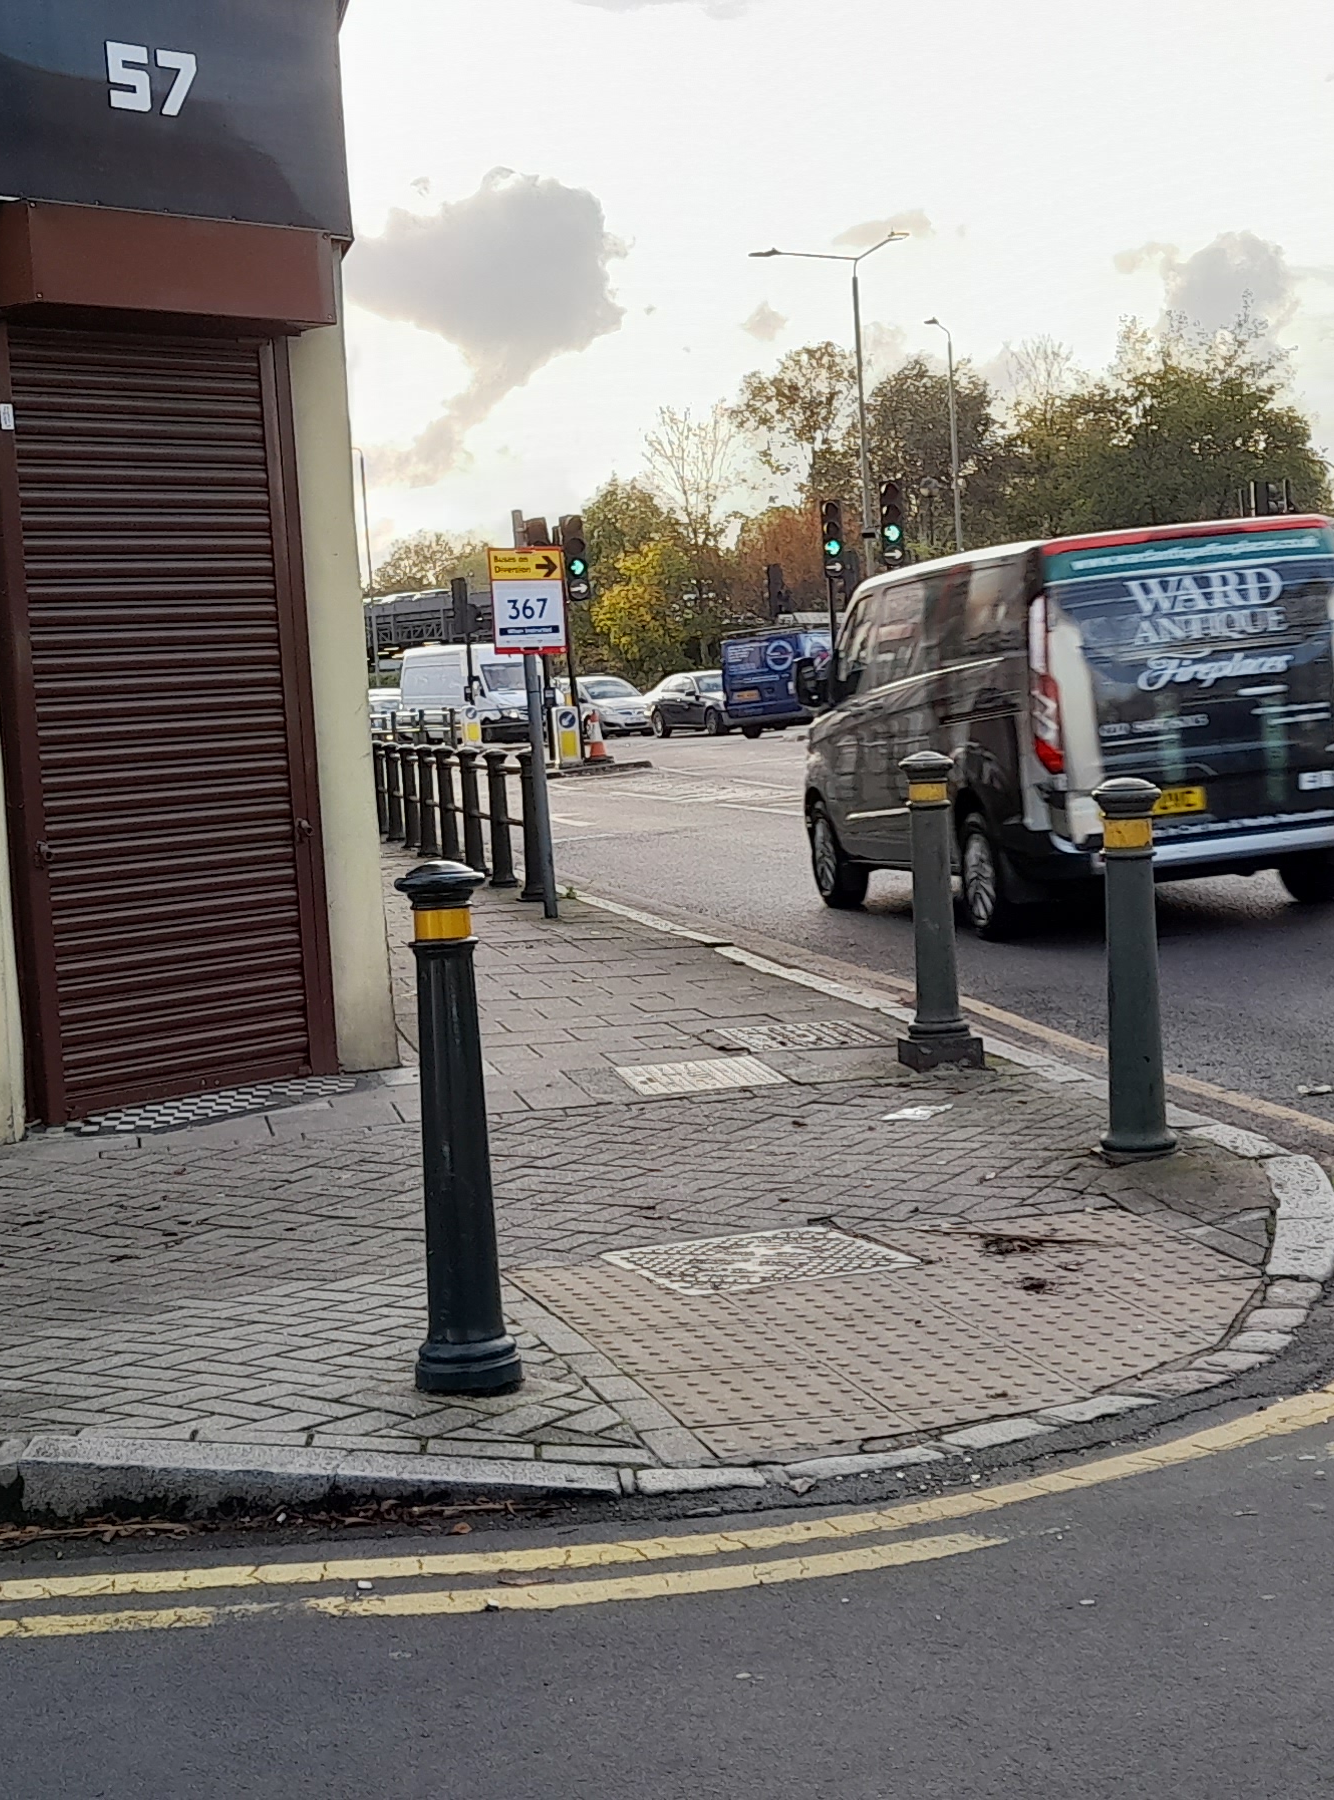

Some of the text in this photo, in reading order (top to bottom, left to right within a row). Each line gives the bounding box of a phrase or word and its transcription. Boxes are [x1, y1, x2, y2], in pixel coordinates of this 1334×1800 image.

[105, 40, 198, 117] 57
[507, 597, 548, 620] 367
[1123, 567, 1284, 616] WARD
[1135, 606, 1288, 646] ANTIQUE
[1137, 650, 1295, 691] Fireplaces
